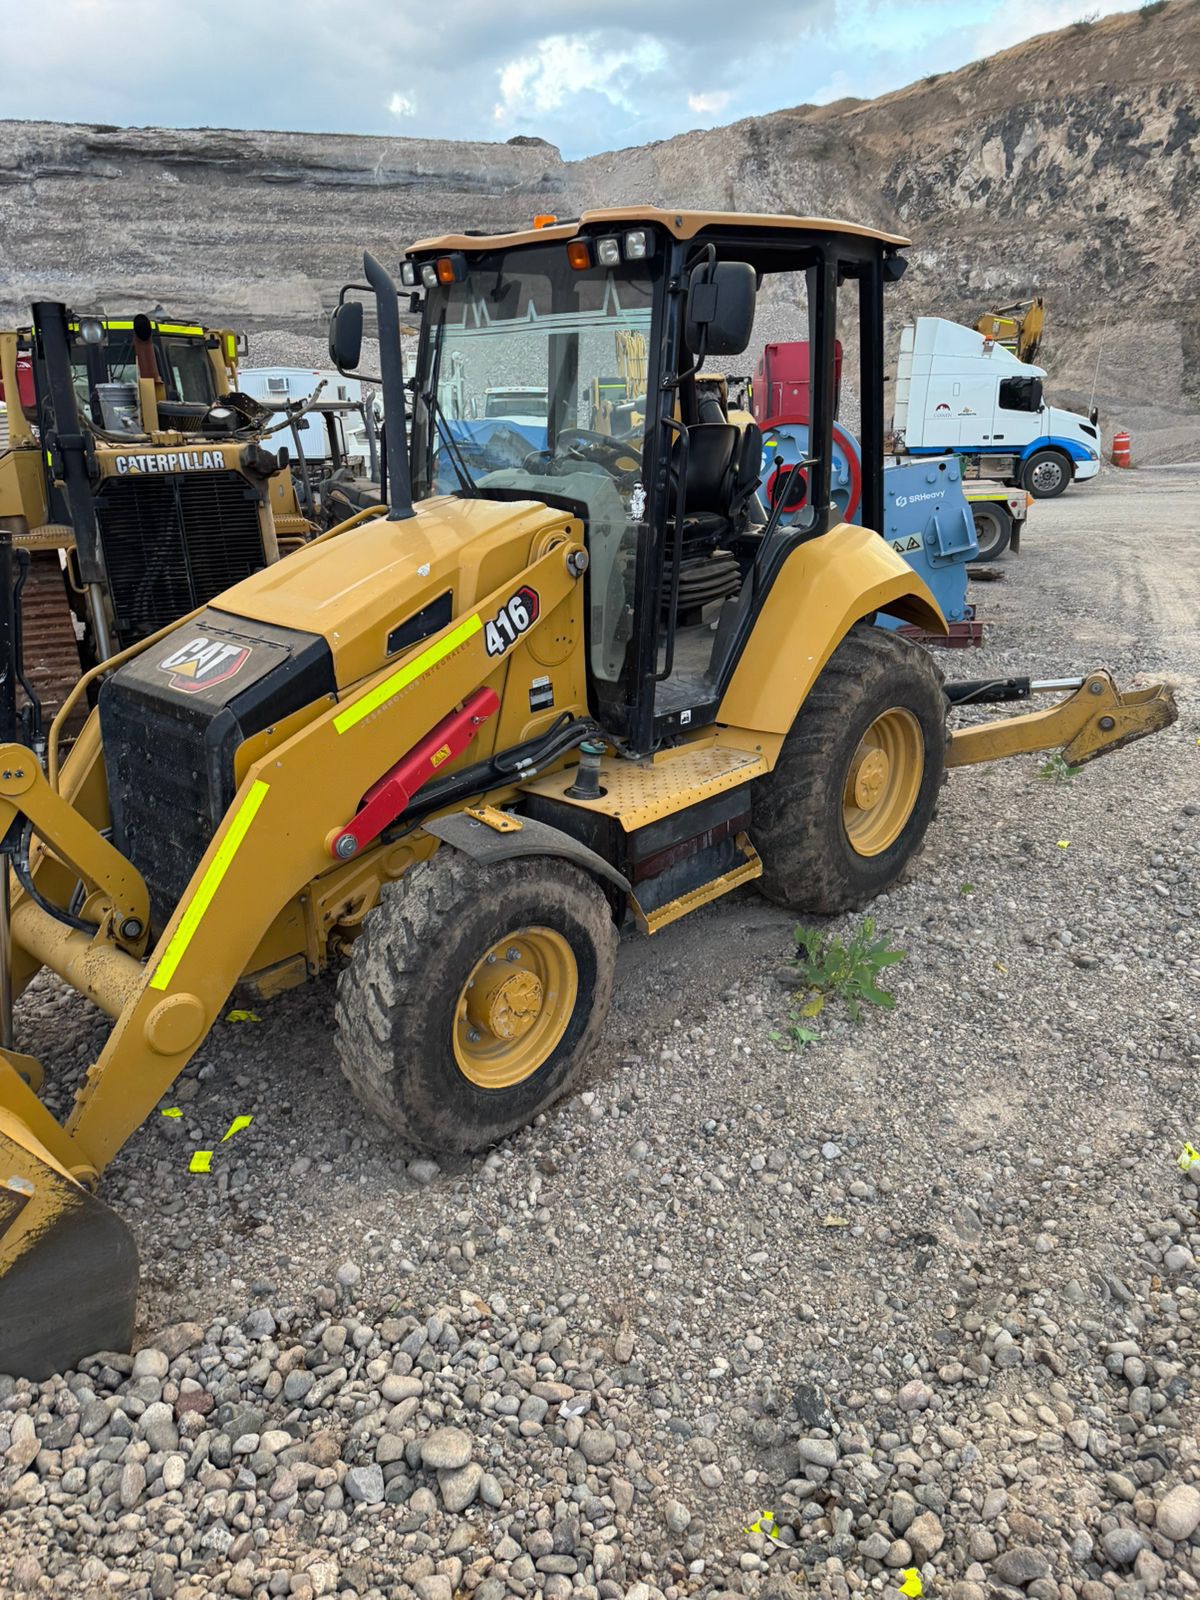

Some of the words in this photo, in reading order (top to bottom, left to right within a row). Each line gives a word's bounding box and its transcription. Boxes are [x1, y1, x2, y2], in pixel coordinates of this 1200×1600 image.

[115, 450, 225, 474] CATERPILLAR
[908, 489, 946, 504] SRHeavy
[485, 595, 530, 655] 416
[160, 637, 243, 680] CAT
